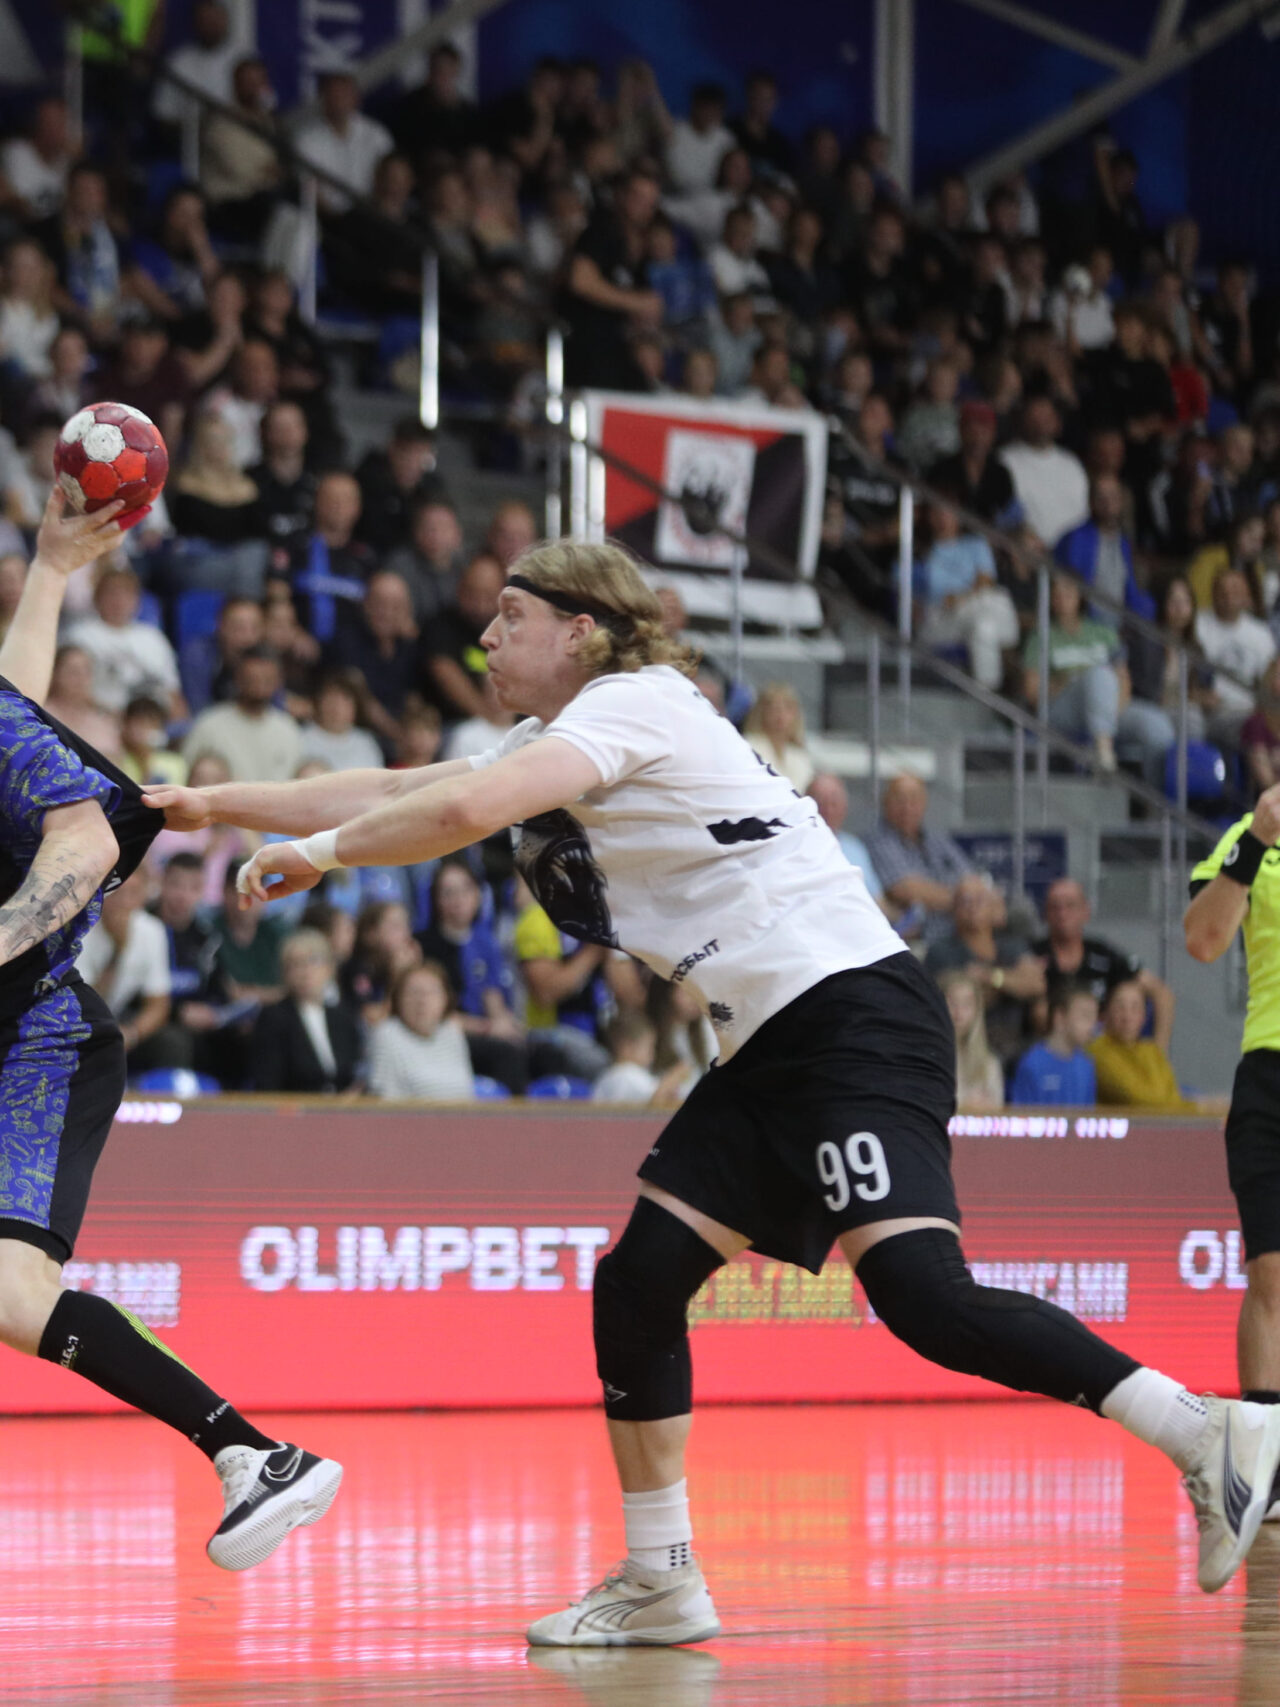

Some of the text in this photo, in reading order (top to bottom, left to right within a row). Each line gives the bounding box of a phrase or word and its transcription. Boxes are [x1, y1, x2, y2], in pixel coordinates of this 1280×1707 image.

[816, 1131, 891, 1212] 99
[240, 1226, 610, 1291] OLIMPBET
[1179, 1230, 1249, 1290] OL
[206, 1401, 230, 1424] Kem
